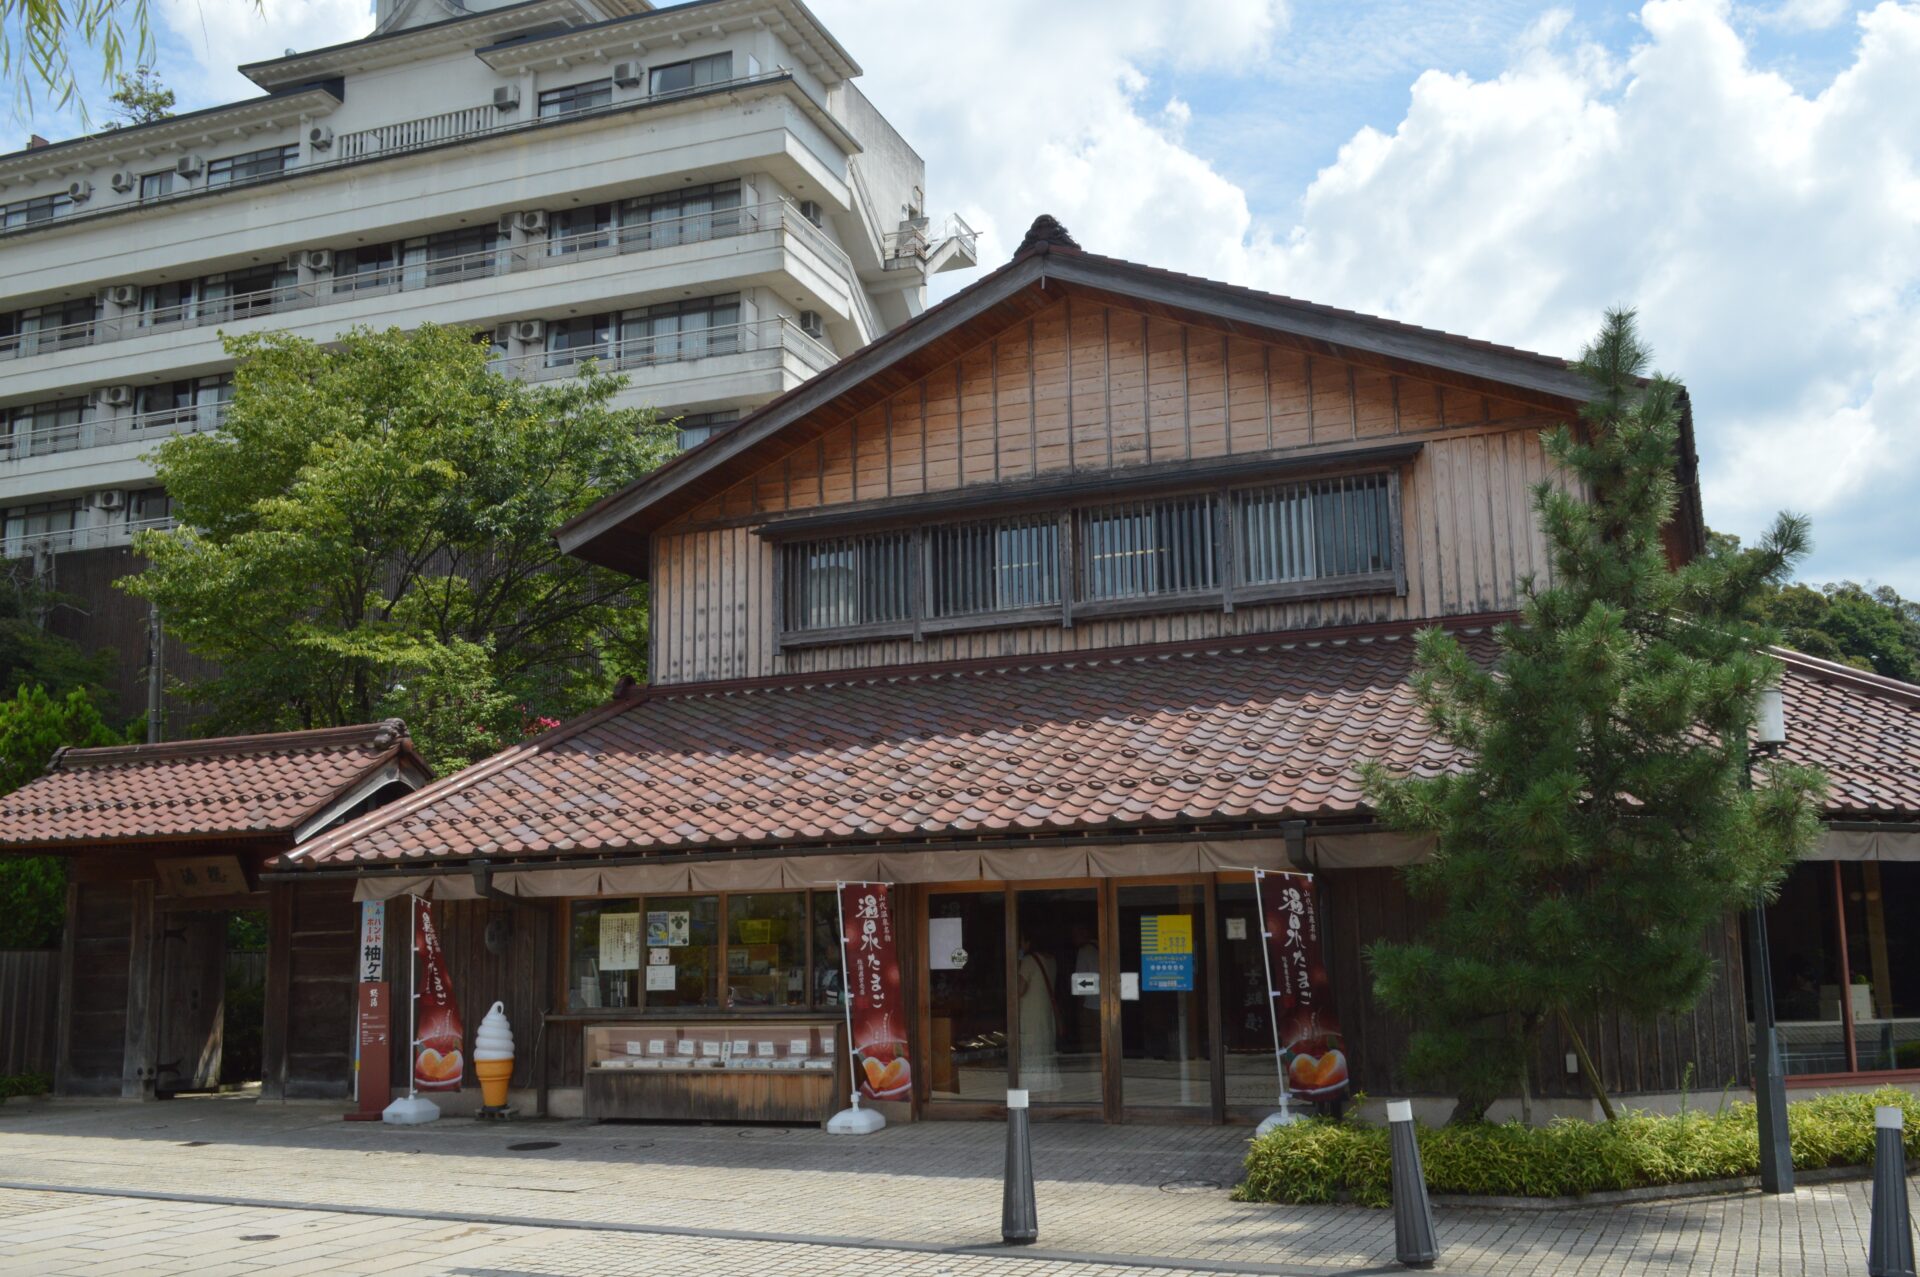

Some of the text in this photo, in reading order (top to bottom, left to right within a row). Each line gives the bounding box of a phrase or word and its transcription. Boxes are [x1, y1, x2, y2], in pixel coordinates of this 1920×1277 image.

[855, 894, 885, 1009] 温泉たまご
[1277, 887, 1312, 1005] 温泉たまご
